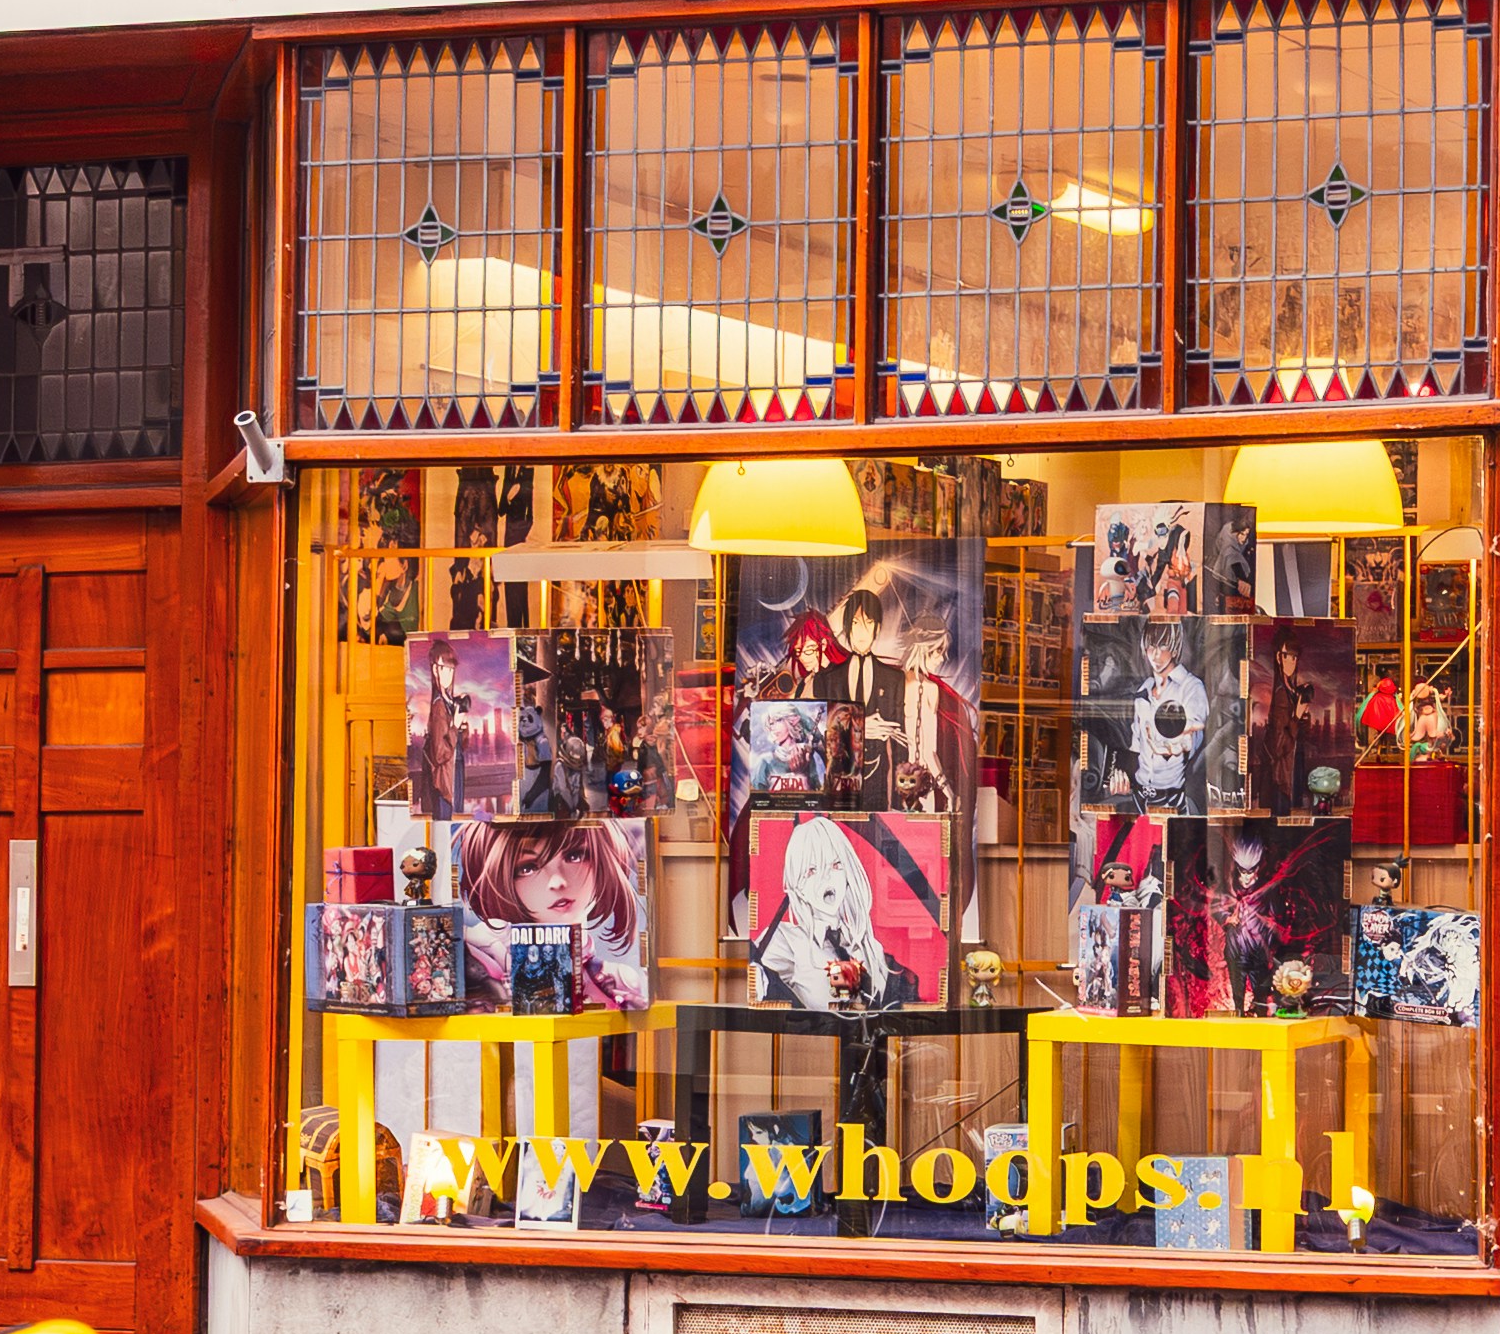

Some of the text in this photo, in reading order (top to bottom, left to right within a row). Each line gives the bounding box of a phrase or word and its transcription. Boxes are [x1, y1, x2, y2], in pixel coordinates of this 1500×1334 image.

[769, 775, 805, 793] ZELDA
[511, 926, 571, 945] DAI DARK
[439, 1122, 1360, 1227] www.whoops.nl
